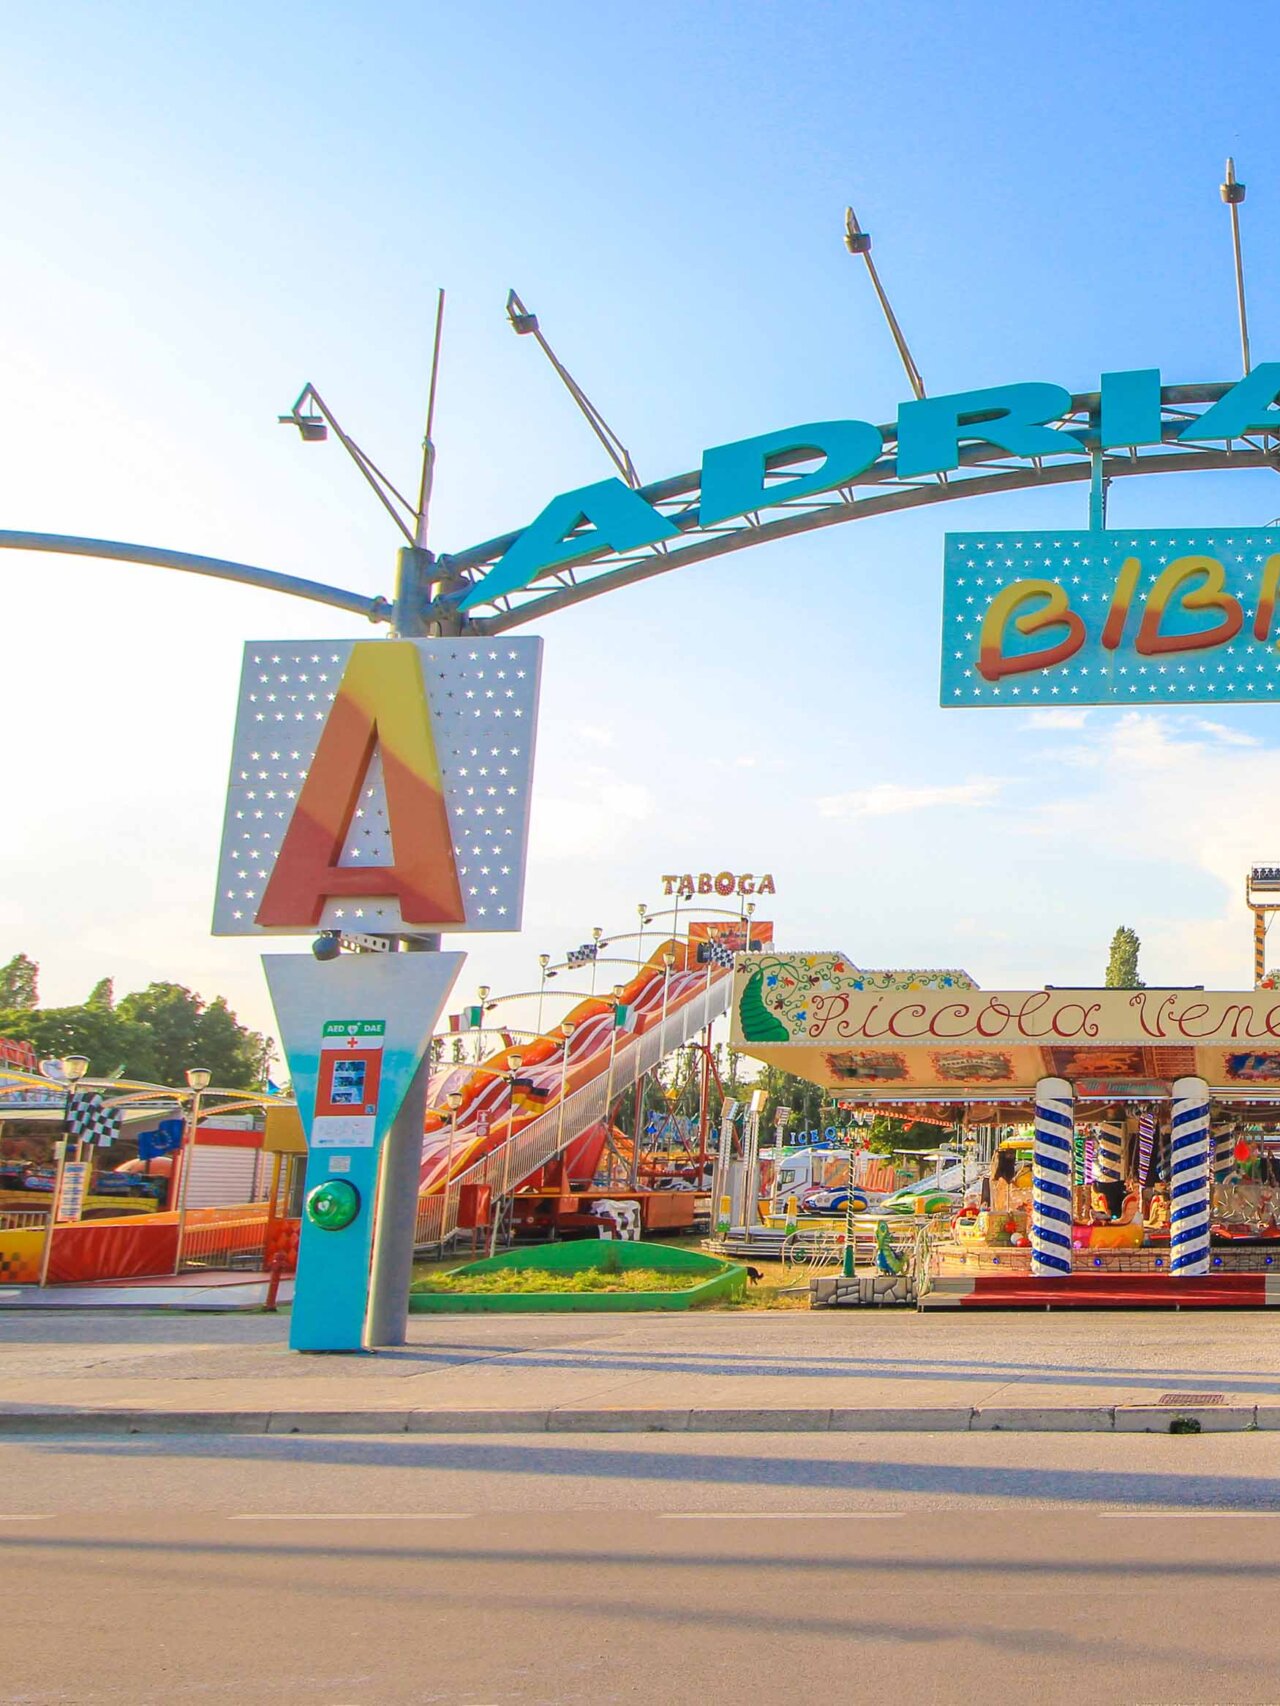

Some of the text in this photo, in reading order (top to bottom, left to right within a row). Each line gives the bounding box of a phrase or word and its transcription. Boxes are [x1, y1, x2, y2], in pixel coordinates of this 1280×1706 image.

[253, 640, 466, 928] A
[661, 871, 776, 896] TABOGA
[808, 991, 1101, 1038] Piccola
[327, 1025, 345, 1033] AED
[790, 1129, 819, 1145] ICE
